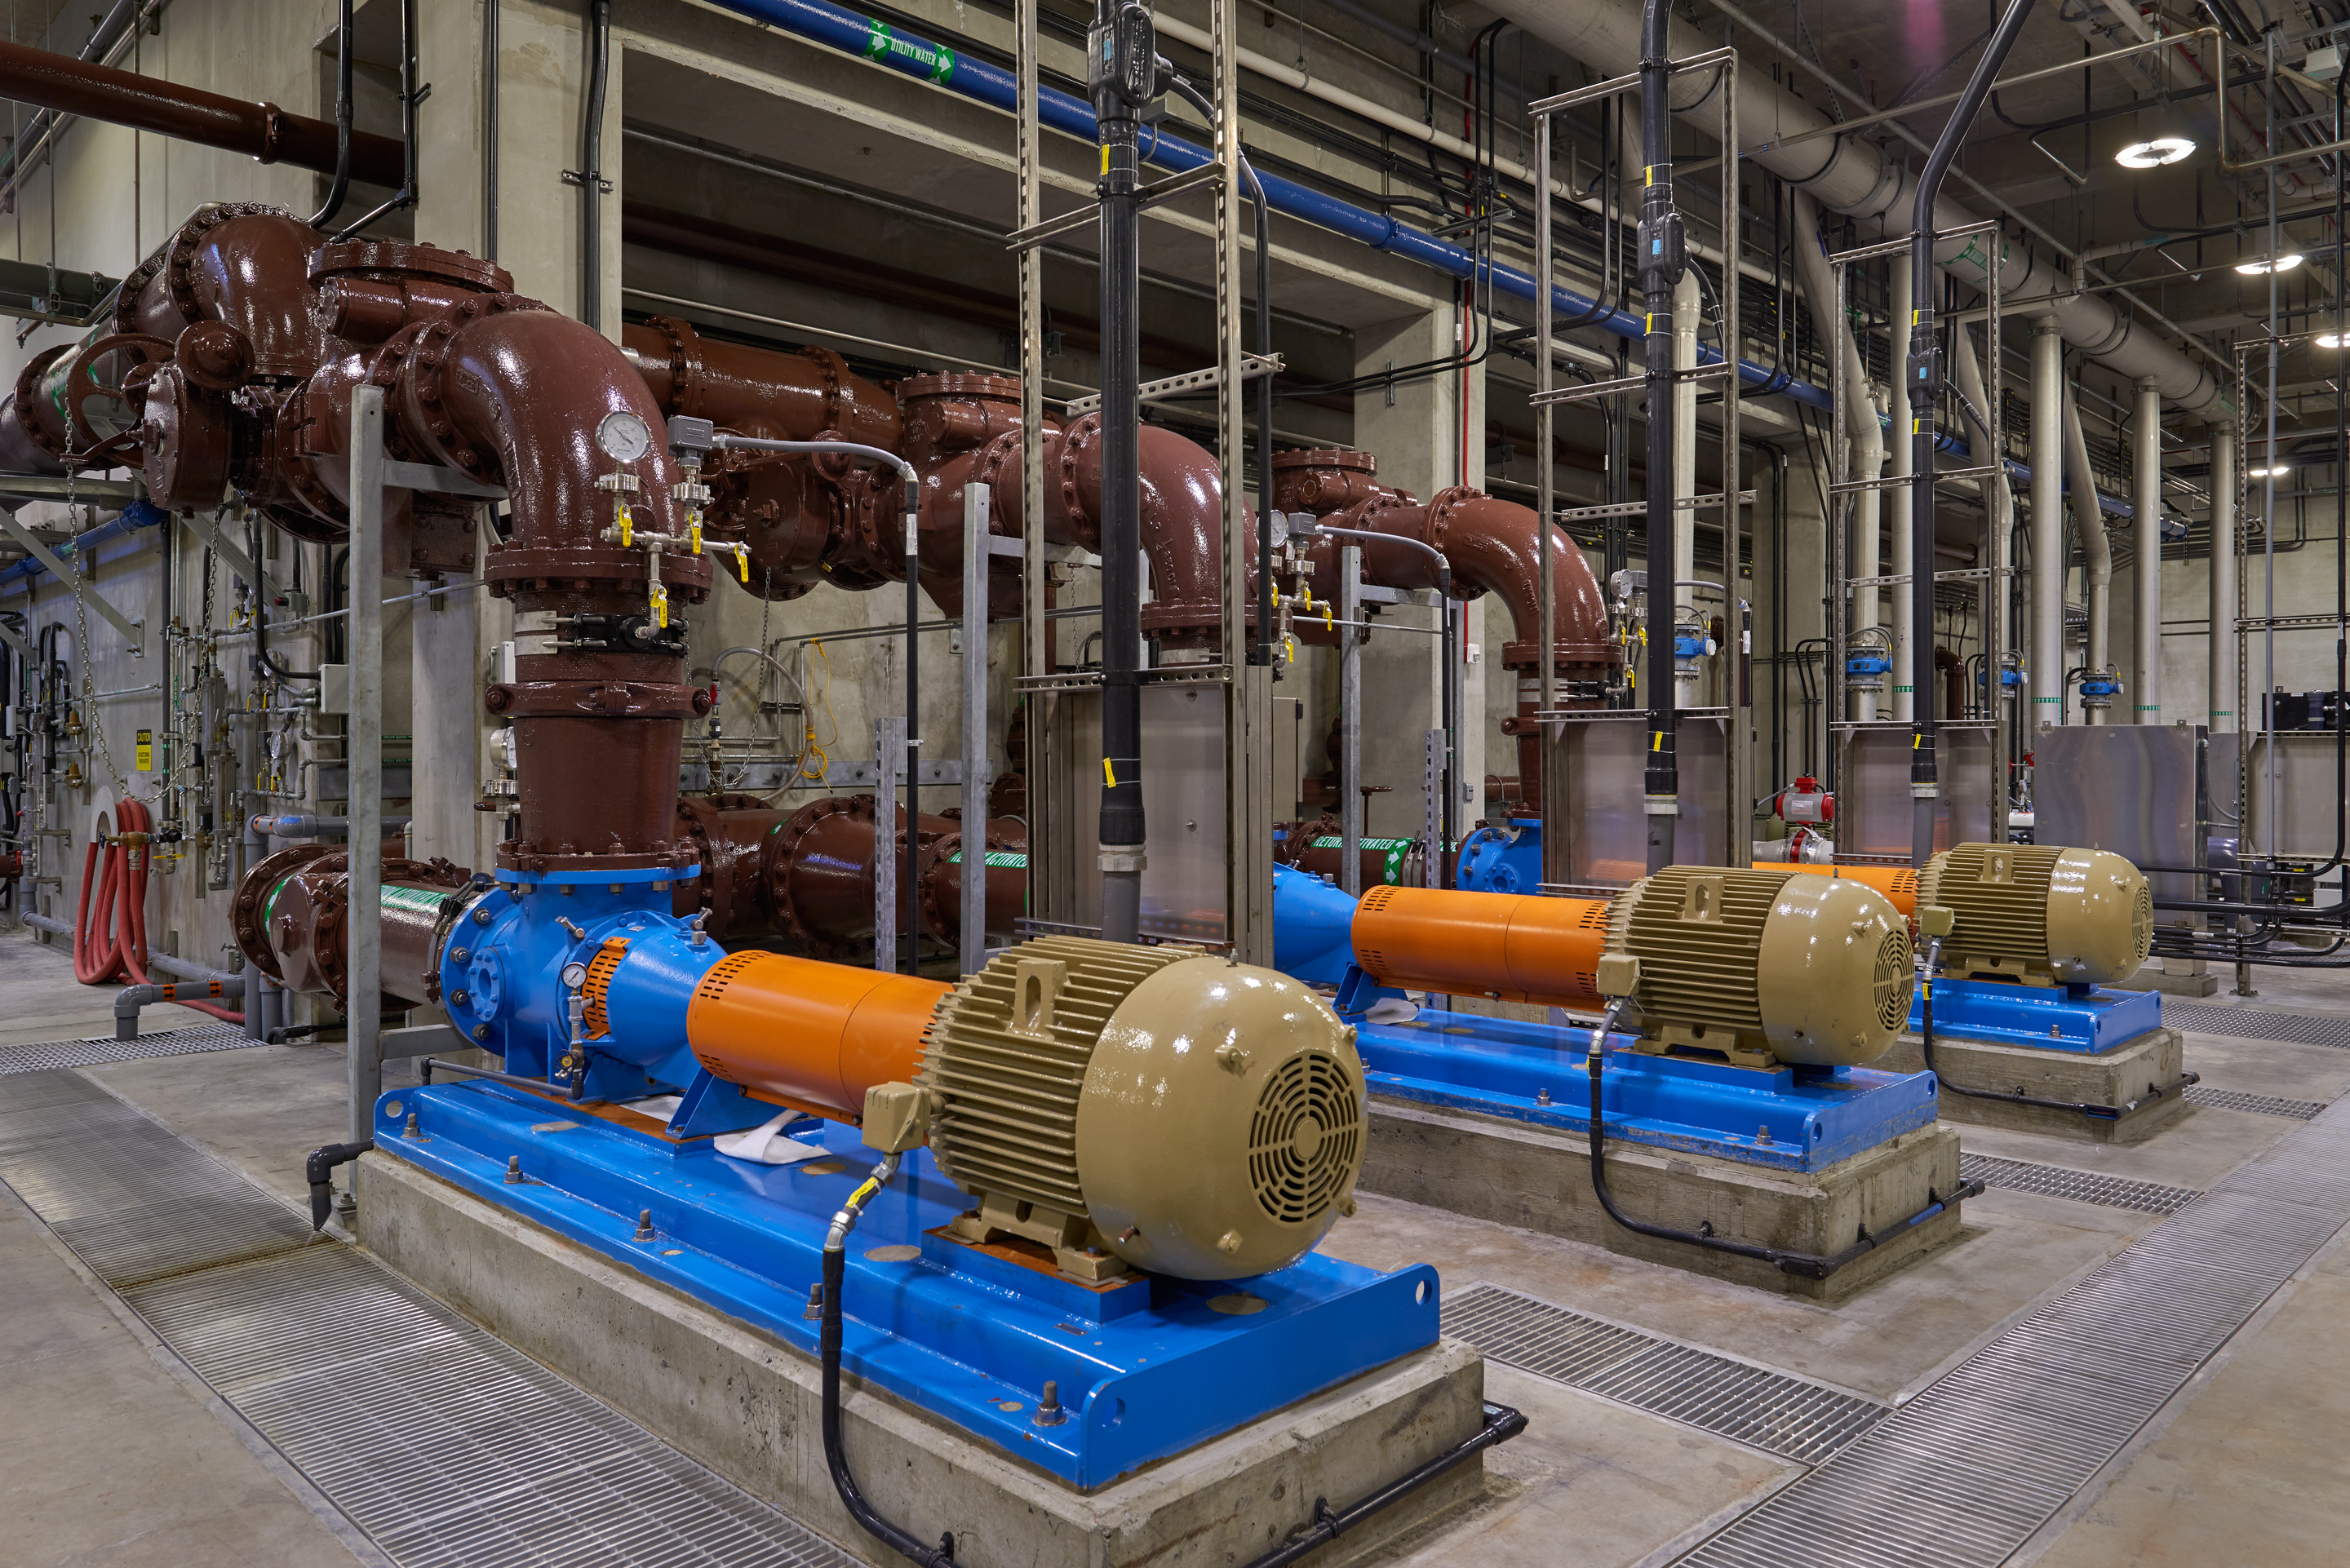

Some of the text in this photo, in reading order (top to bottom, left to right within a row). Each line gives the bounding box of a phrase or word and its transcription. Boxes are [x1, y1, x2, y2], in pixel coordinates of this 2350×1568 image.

[890, 38, 937, 67] UTILITY WATER
[137, 733, 151, 742] CAUTION
[1314, 836, 1396, 850] RETUR TIVATED
